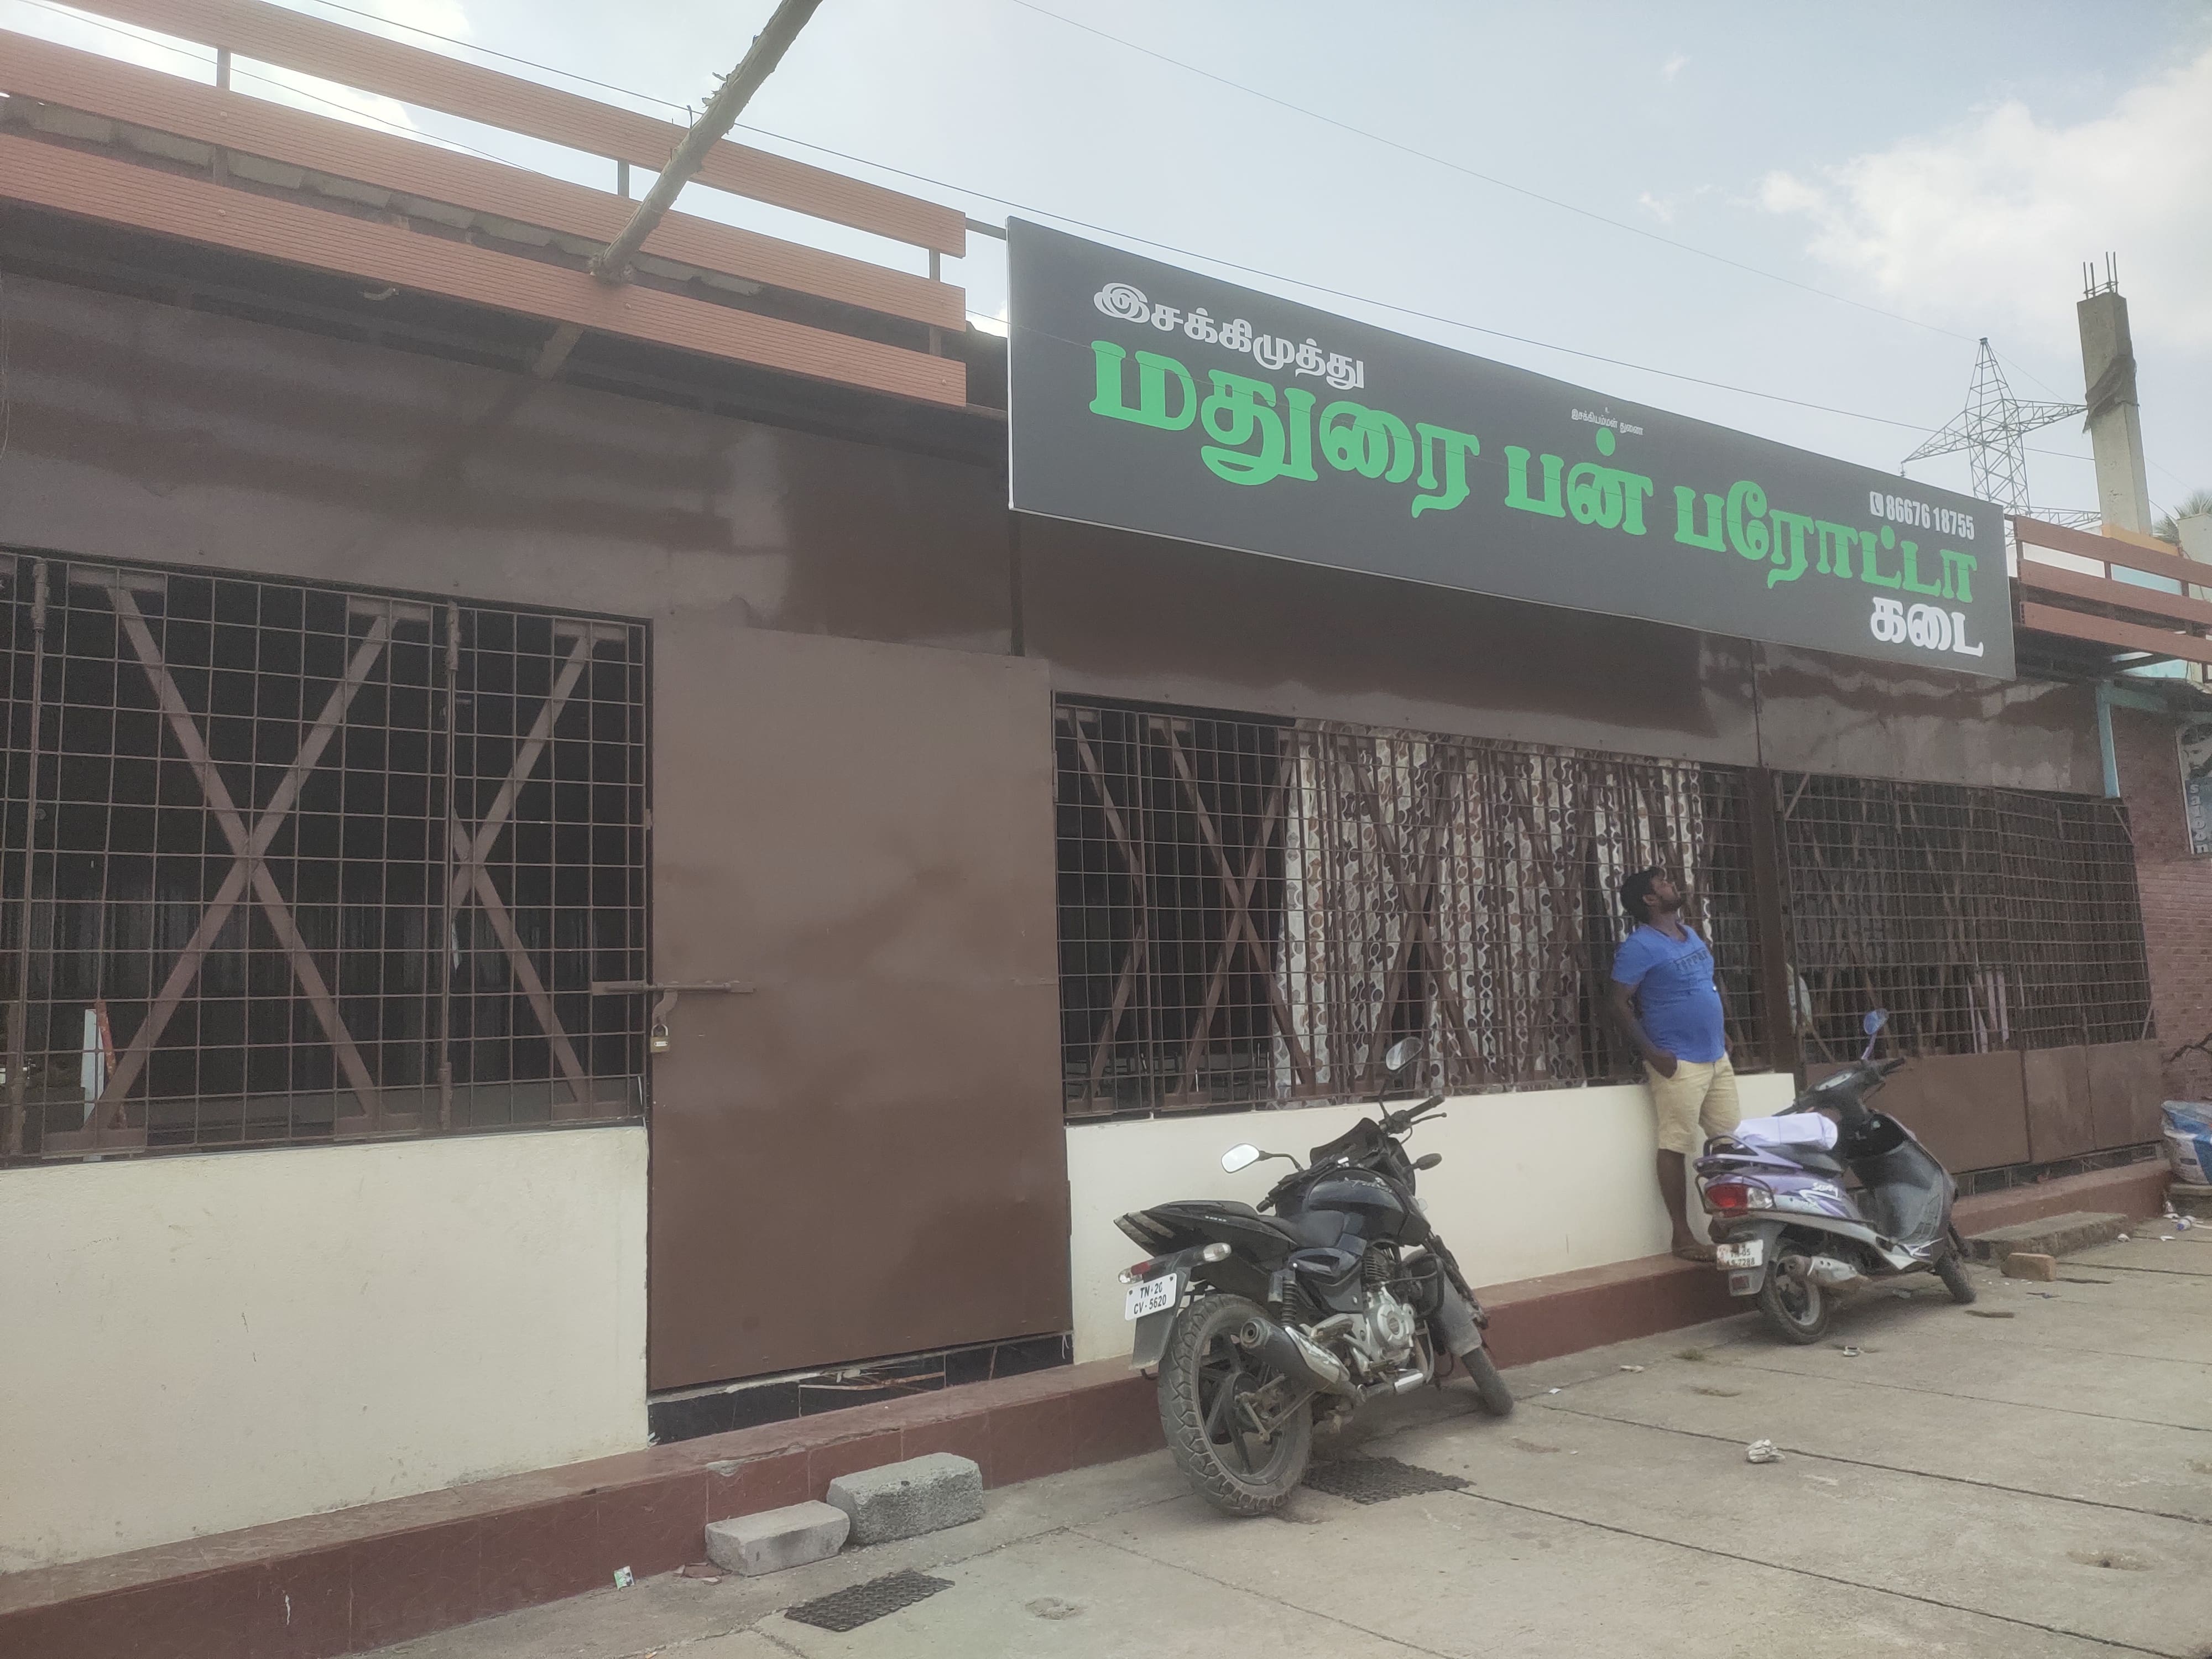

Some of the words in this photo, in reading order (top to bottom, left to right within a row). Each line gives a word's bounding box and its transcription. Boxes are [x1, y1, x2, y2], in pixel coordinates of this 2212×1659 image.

[1093, 283, 1365, 390] இசக்கிமுத்து
[1088, 340, 1481, 518] மதுரை
[1504, 427, 1653, 535] பன்
[1674, 481, 1977, 603] பரோட்டா
[1886, 495, 1931, 529] 86676
[1933, 507, 1975, 540] 18755
[1870, 596, 1985, 658] கடை
